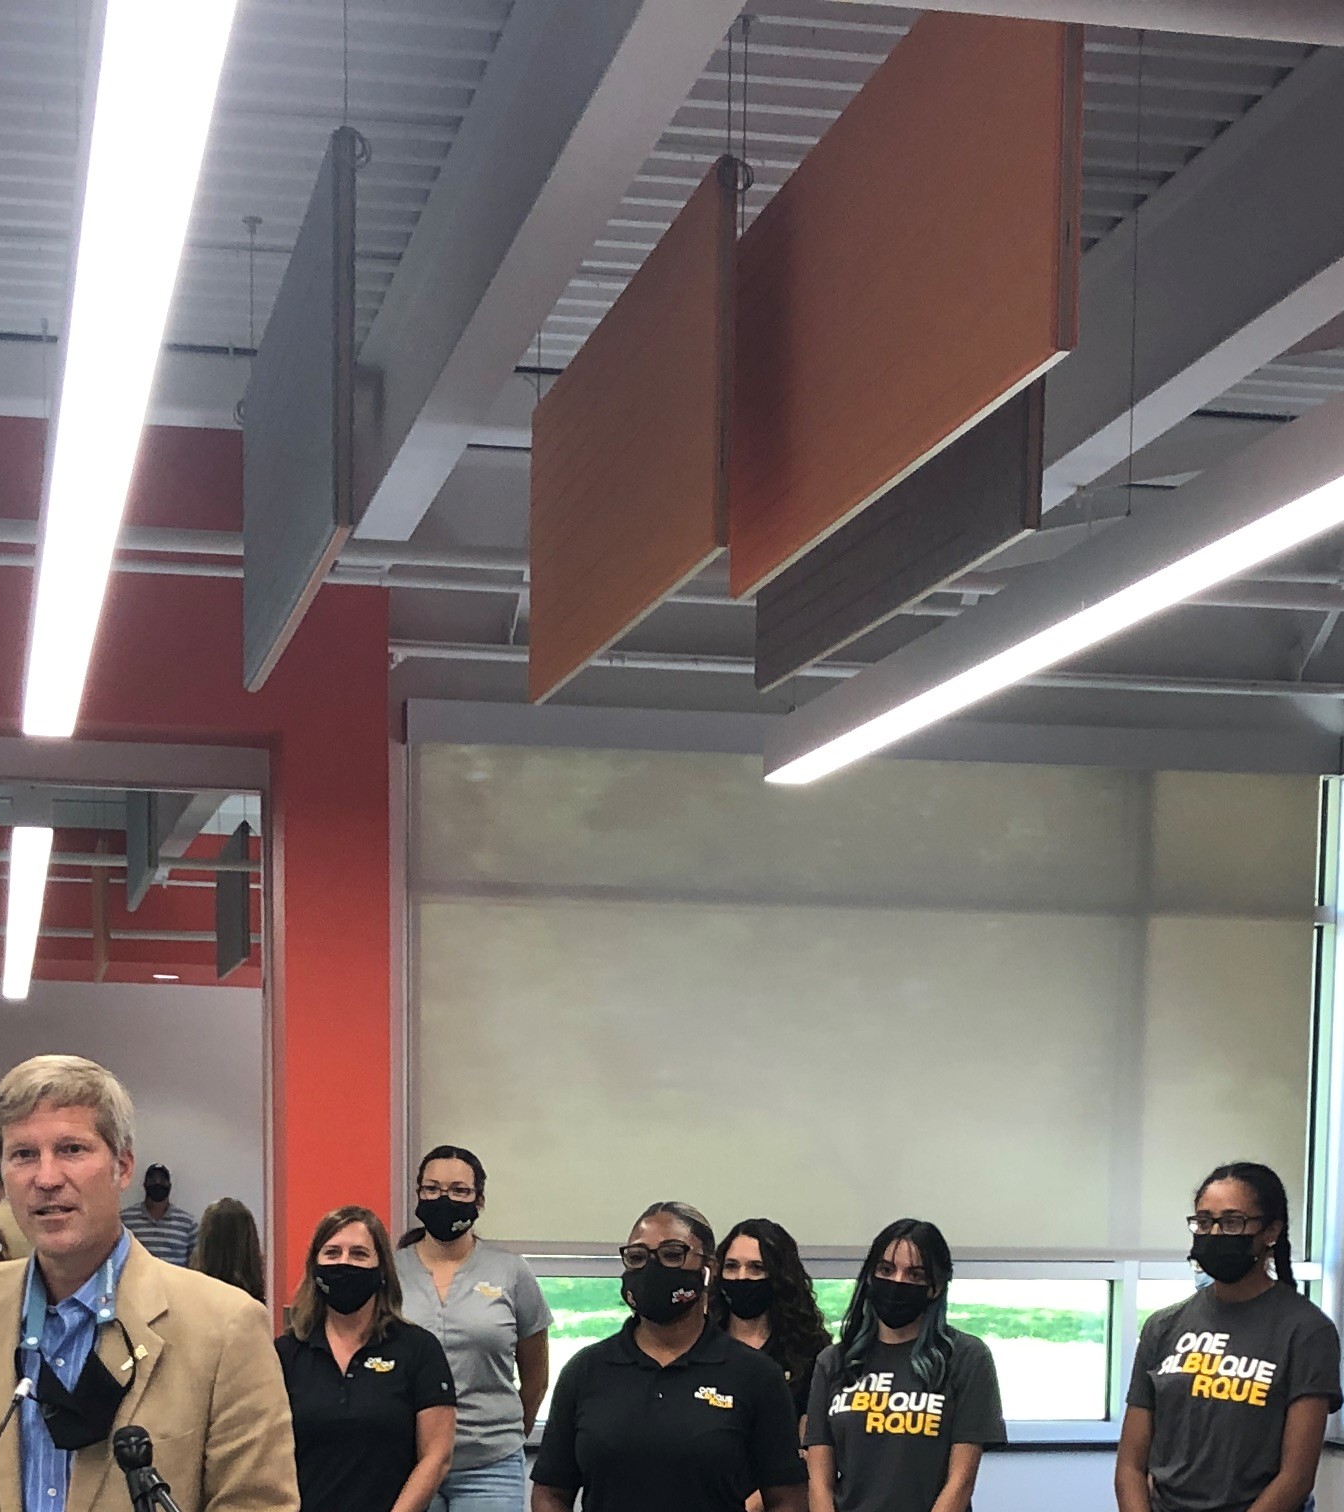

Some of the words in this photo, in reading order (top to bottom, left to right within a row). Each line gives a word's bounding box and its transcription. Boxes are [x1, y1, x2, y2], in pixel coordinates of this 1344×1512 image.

[1175, 1331, 1230, 1355] ONE
[1157, 1352, 1277, 1385] ALBUQUE
[1191, 1374, 1271, 1407] RQUE
[828, 1391, 946, 1417] ALBUQUE
[865, 1411, 942, 1436] RQUE
